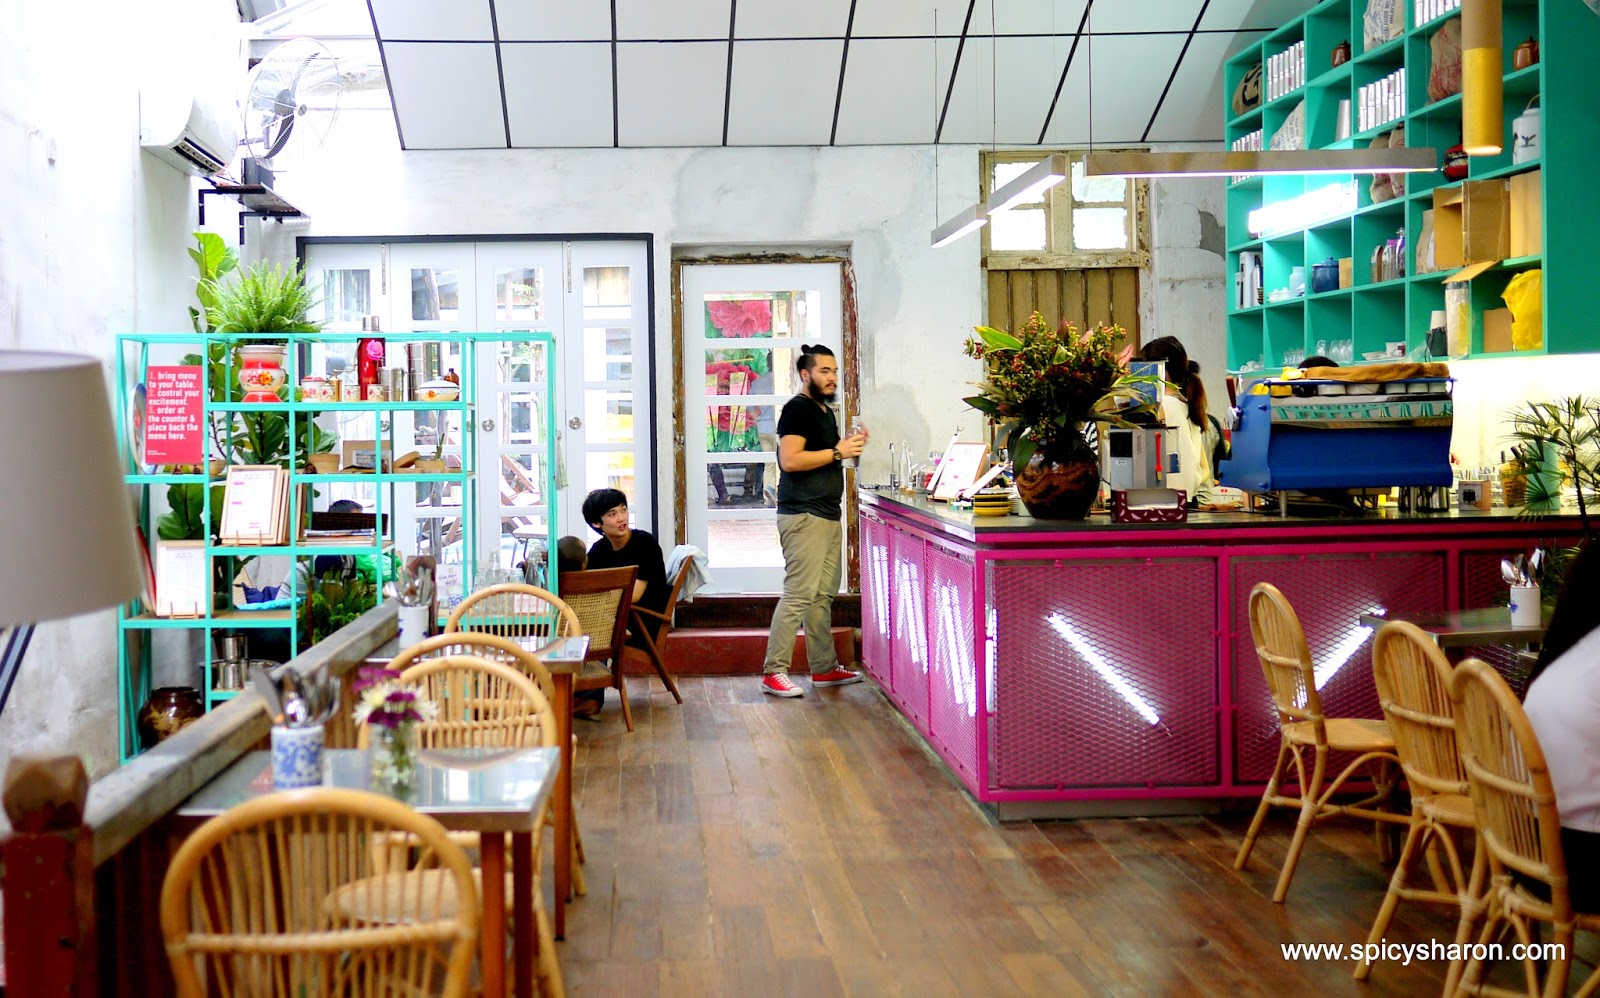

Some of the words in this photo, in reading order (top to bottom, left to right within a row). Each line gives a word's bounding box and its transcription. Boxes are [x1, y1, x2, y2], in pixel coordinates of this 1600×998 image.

[157, 371, 176, 382] bring
[158, 381, 174, 390] your
[175, 380, 196, 388] table.
[157, 389, 183, 397] control
[184, 390, 200, 399] your
[148, 397, 189, 406] excitement.
[157, 406, 176, 414] order
[177, 406, 185, 414] at
[148, 415, 160, 423] the
[161, 415, 188, 423] counter
[189, 414, 195, 423] &
[147, 423, 167, 433] place
[168, 423, 186, 431] back
[186, 423, 199, 431] the
[168, 432, 187, 440] here.
